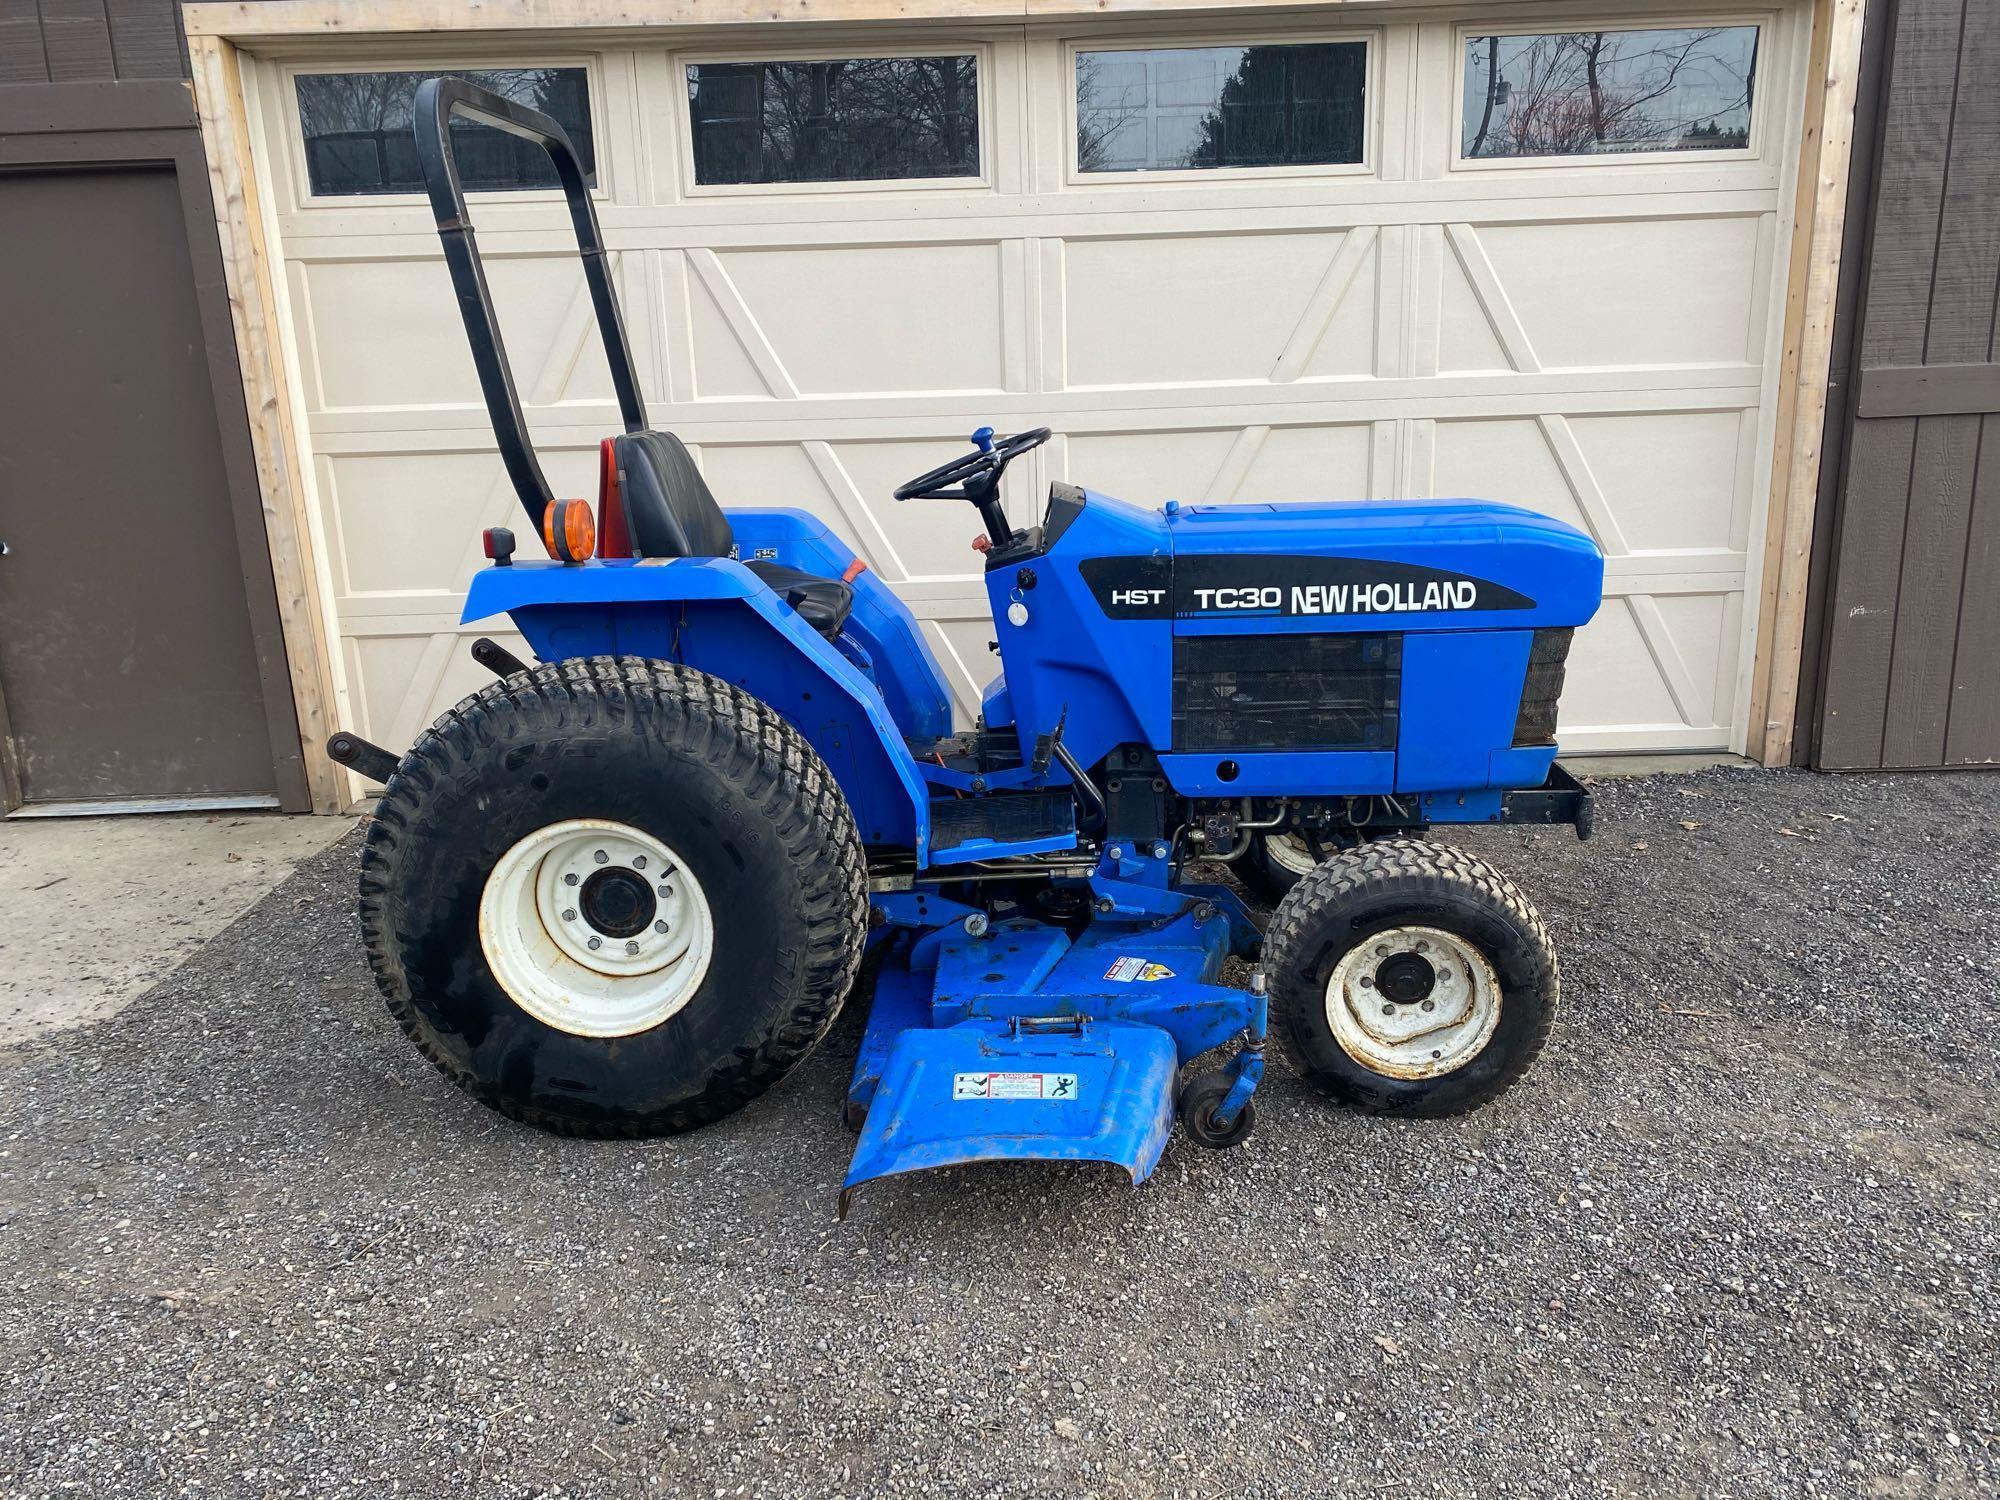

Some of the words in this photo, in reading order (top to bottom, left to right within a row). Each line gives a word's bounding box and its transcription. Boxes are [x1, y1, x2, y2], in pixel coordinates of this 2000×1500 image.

[1112, 590, 1166, 604] HST
[1194, 587, 1282, 609] TC30
[1291, 585, 1348, 614] NEW
[1352, 581, 1477, 612] HOLLAND
